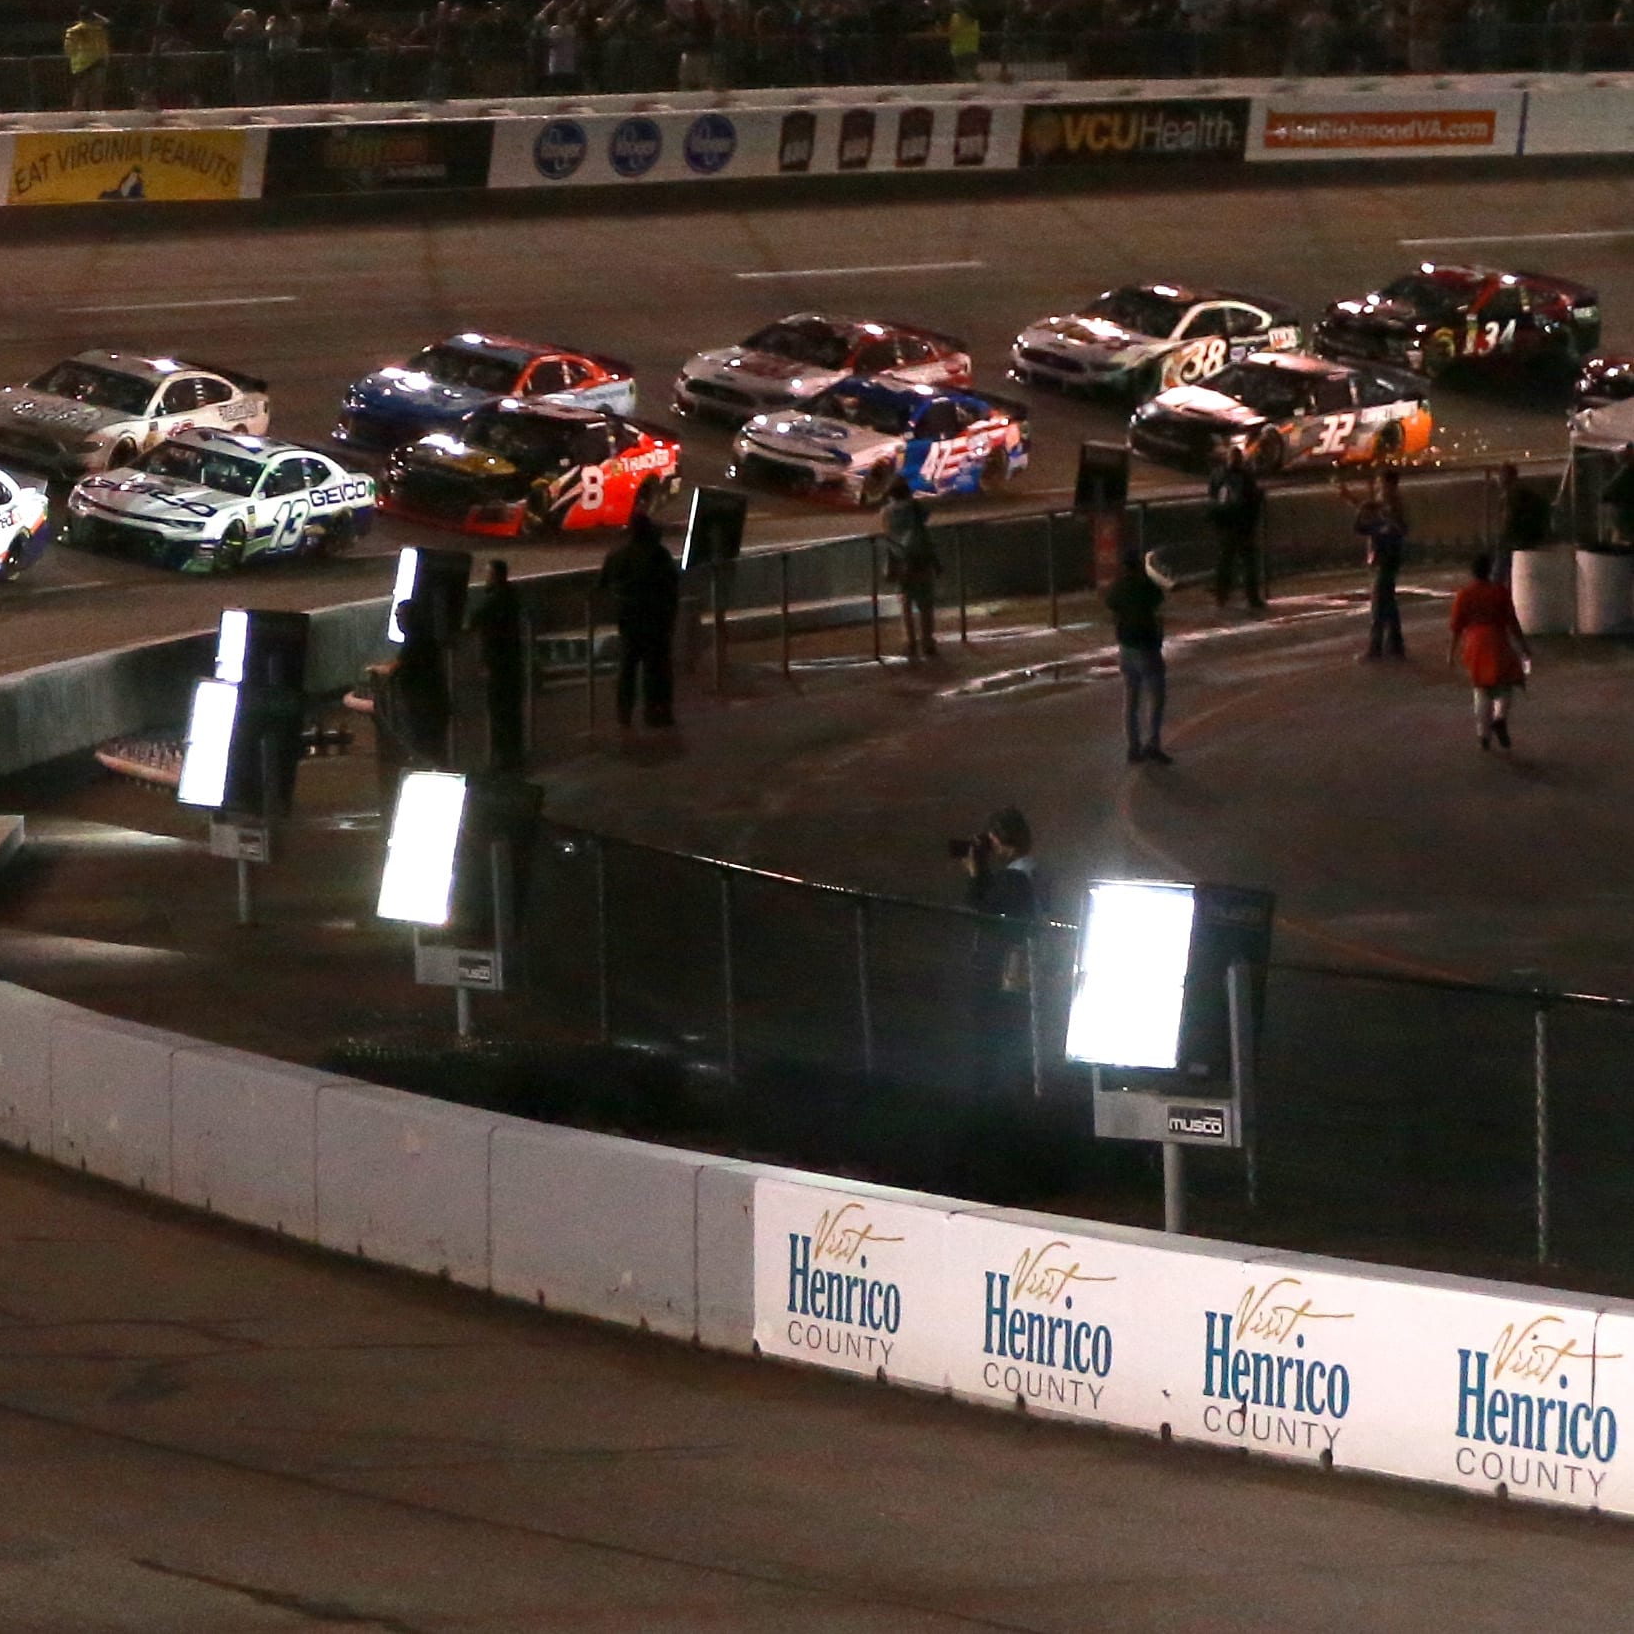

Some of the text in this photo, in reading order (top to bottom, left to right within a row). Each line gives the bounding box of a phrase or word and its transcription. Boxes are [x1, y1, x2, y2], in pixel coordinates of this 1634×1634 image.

[14, 135, 238, 195] EAT VIRGINIA PEANUTS
[1179, 337, 1227, 382] 38
[1477, 318, 1517, 355] 34
[1311, 412, 1357, 456] 32
[308, 480, 367, 508] GEICO
[580, 465, 604, 511] 8
[266, 499, 310, 554] 13
[1168, 1116, 1223, 1135] musco
[814, 1201, 905, 1265] Visit
[787, 1232, 901, 1335] Henrico
[1012, 1240, 1117, 1305] Visit
[983, 1270, 1113, 1378] Henrico
[1235, 1277, 1355, 1345] Visit
[787, 1320, 895, 1366] COUNTY
[1202, 1310, 1350, 1420] Henrico
[1492, 1315, 1623, 1385] Visit
[983, 1361, 1105, 1410] COUNTY
[1455, 1347, 1618, 1464] Henrico
[1203, 1405, 1341, 1453] COUNTY
[1455, 1446, 1609, 1498] COUNTY
